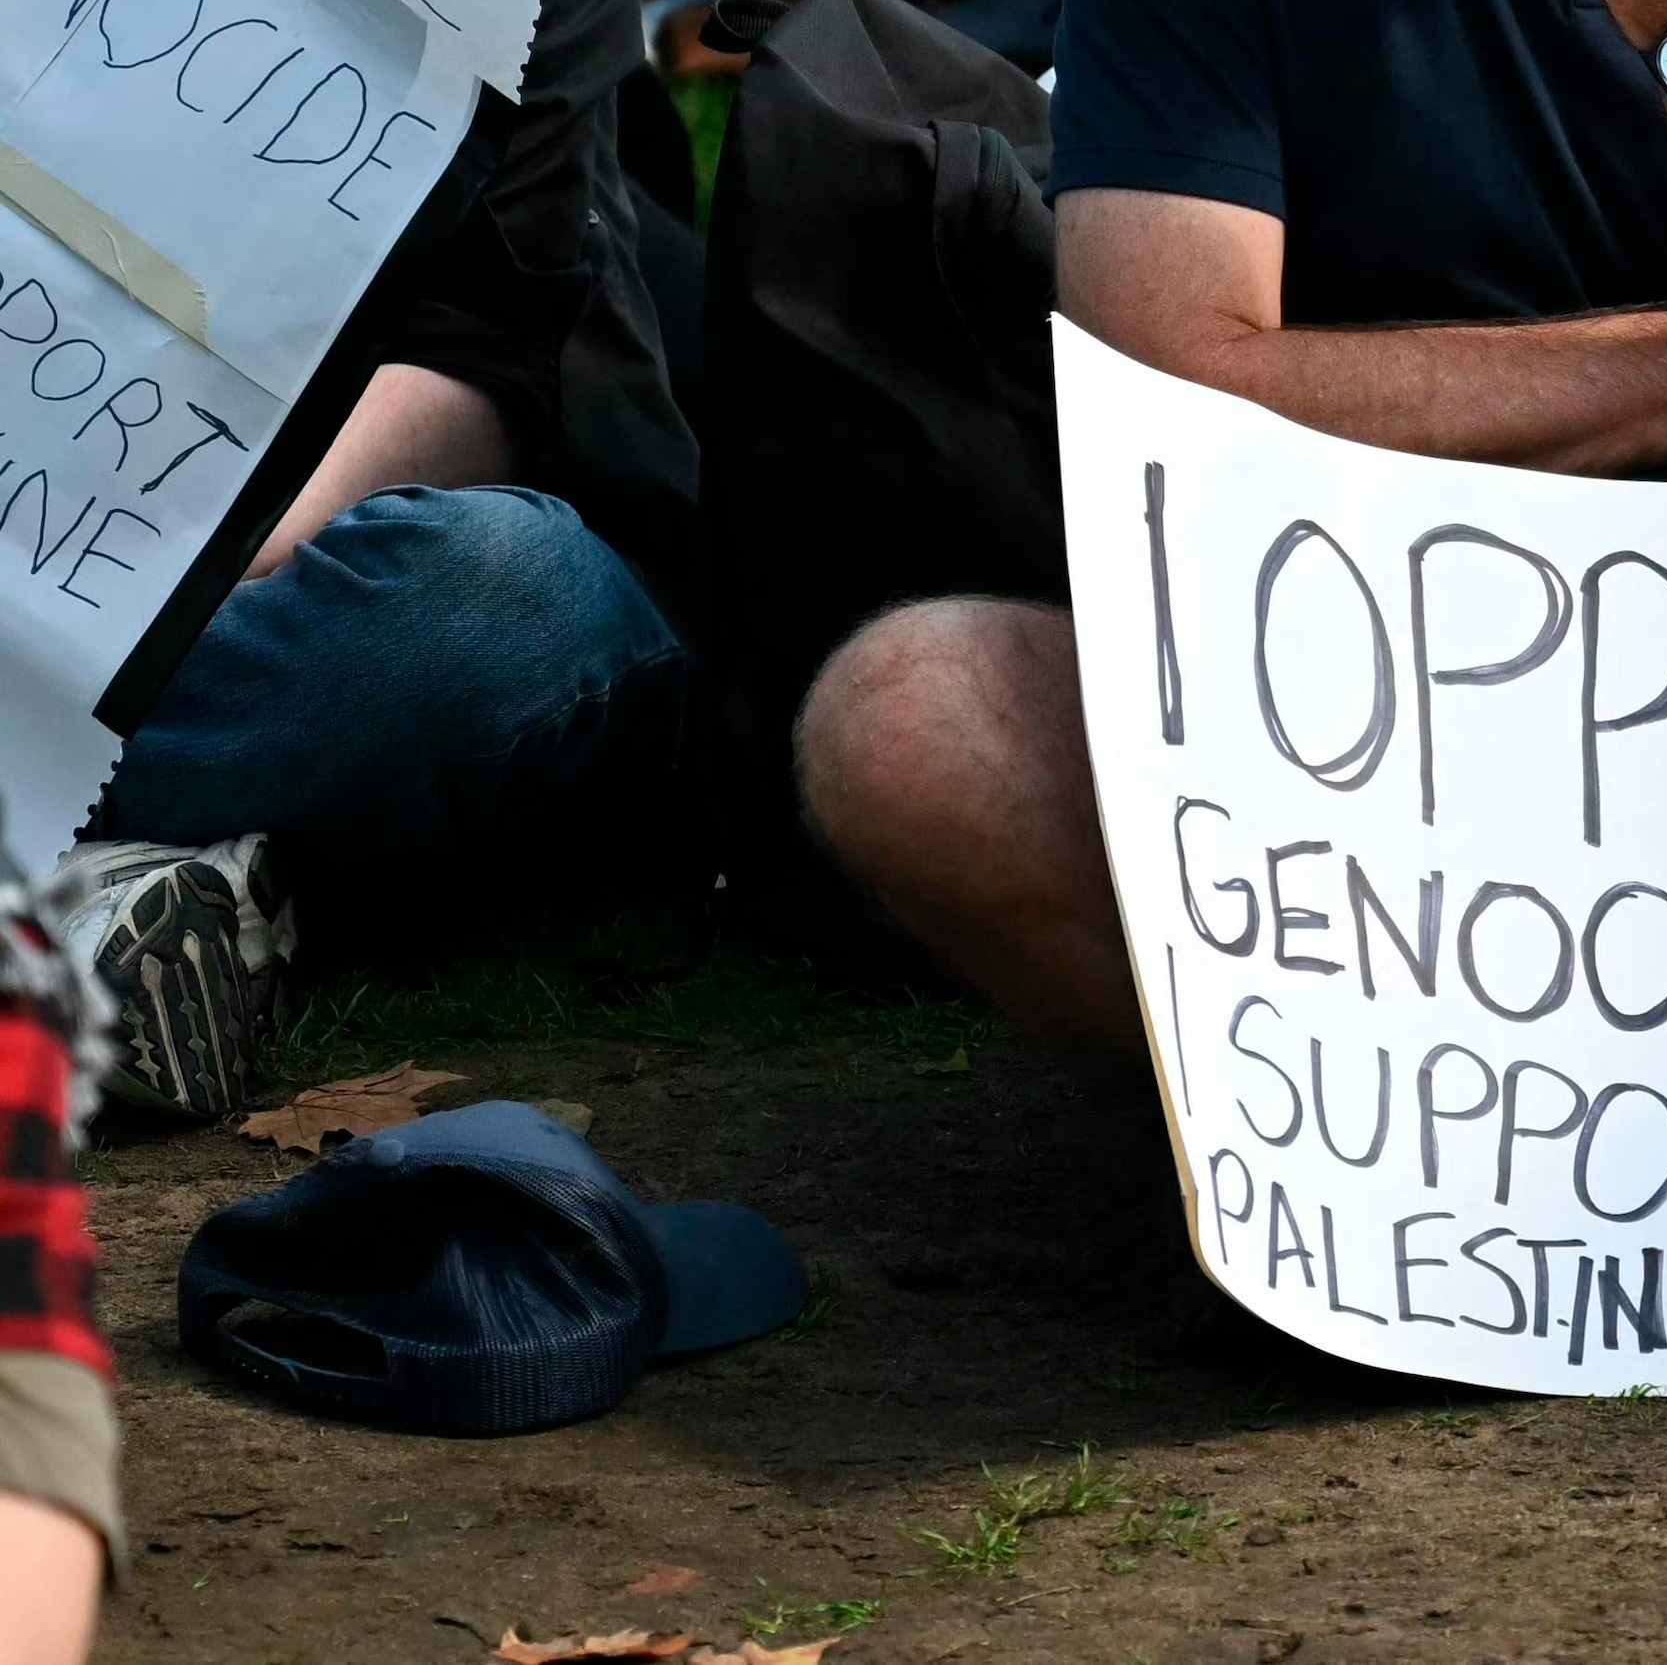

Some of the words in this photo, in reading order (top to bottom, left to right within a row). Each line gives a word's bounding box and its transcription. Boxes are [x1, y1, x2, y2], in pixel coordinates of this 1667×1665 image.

[0, 272, 249, 495] PORT
[1145, 459, 1184, 747] I
[1166, 943, 1190, 1118] I
